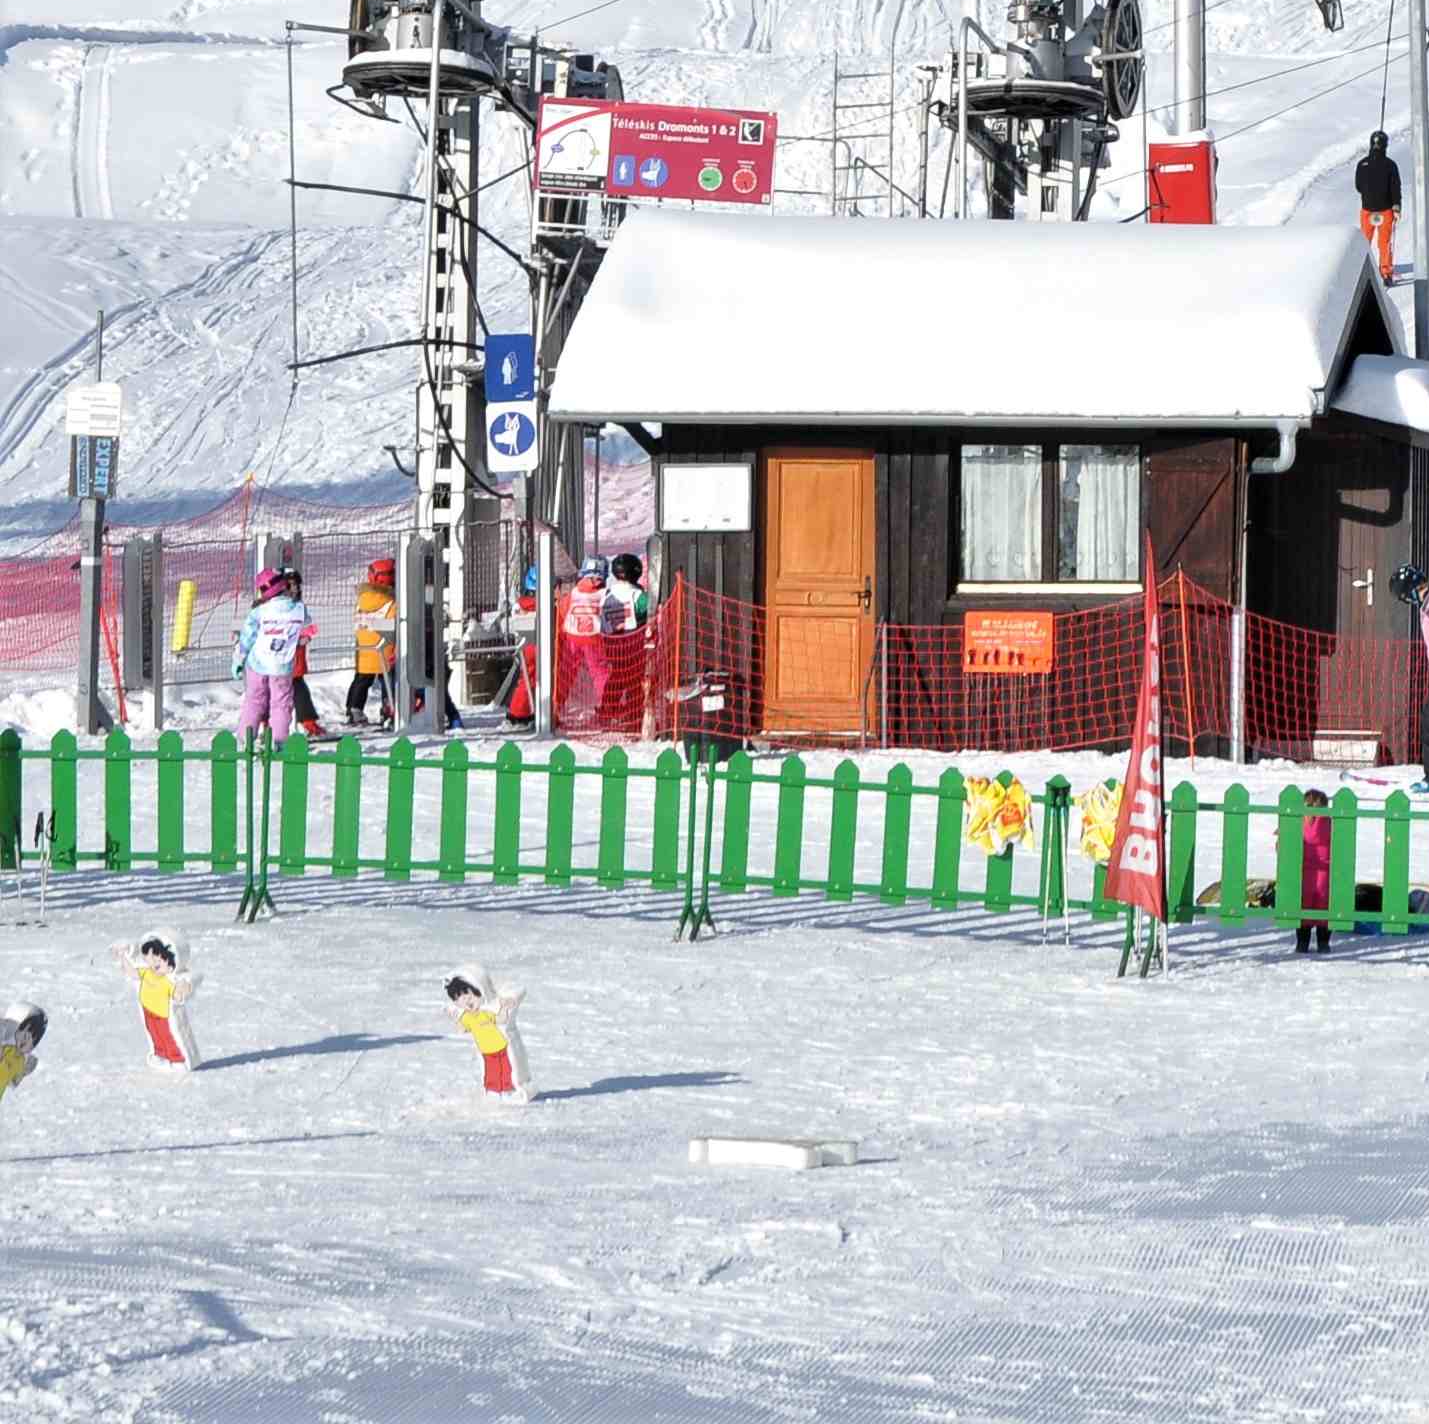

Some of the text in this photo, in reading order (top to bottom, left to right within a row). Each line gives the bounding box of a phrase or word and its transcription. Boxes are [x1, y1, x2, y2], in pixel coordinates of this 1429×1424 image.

[612, 117, 655, 131] Téléskis
[658, 120, 709, 135] Dromonts
[719, 125, 728, 136] &
[728, 125, 737, 137] 2
